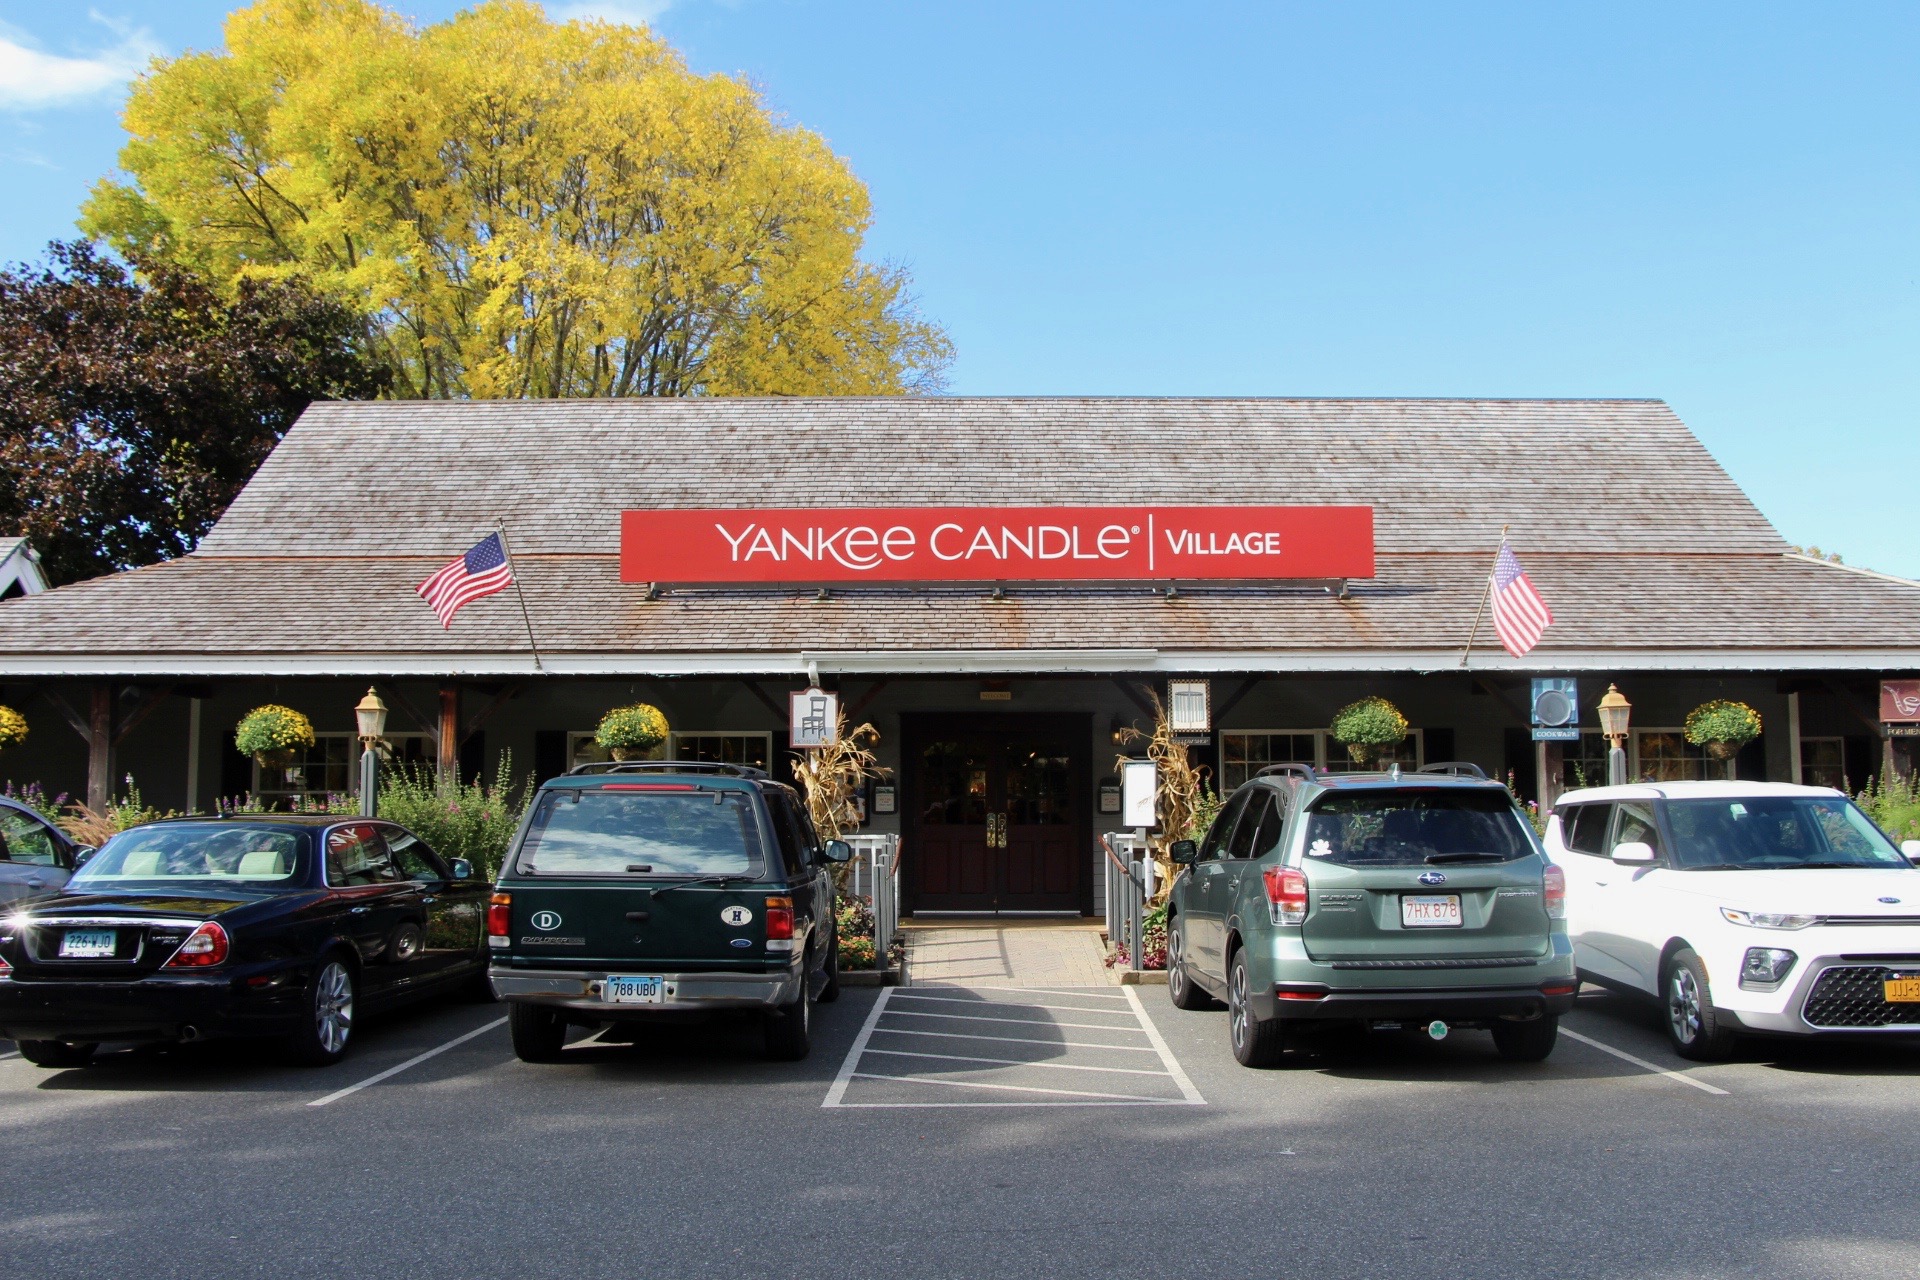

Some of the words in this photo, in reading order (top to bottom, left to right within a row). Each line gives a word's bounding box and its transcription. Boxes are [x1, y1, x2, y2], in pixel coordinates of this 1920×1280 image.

[732, 910, 742, 921] H
[1406, 903, 1430, 918] 7HX
[1433, 902, 1457, 918] 878
[541, 914, 552, 927] D
